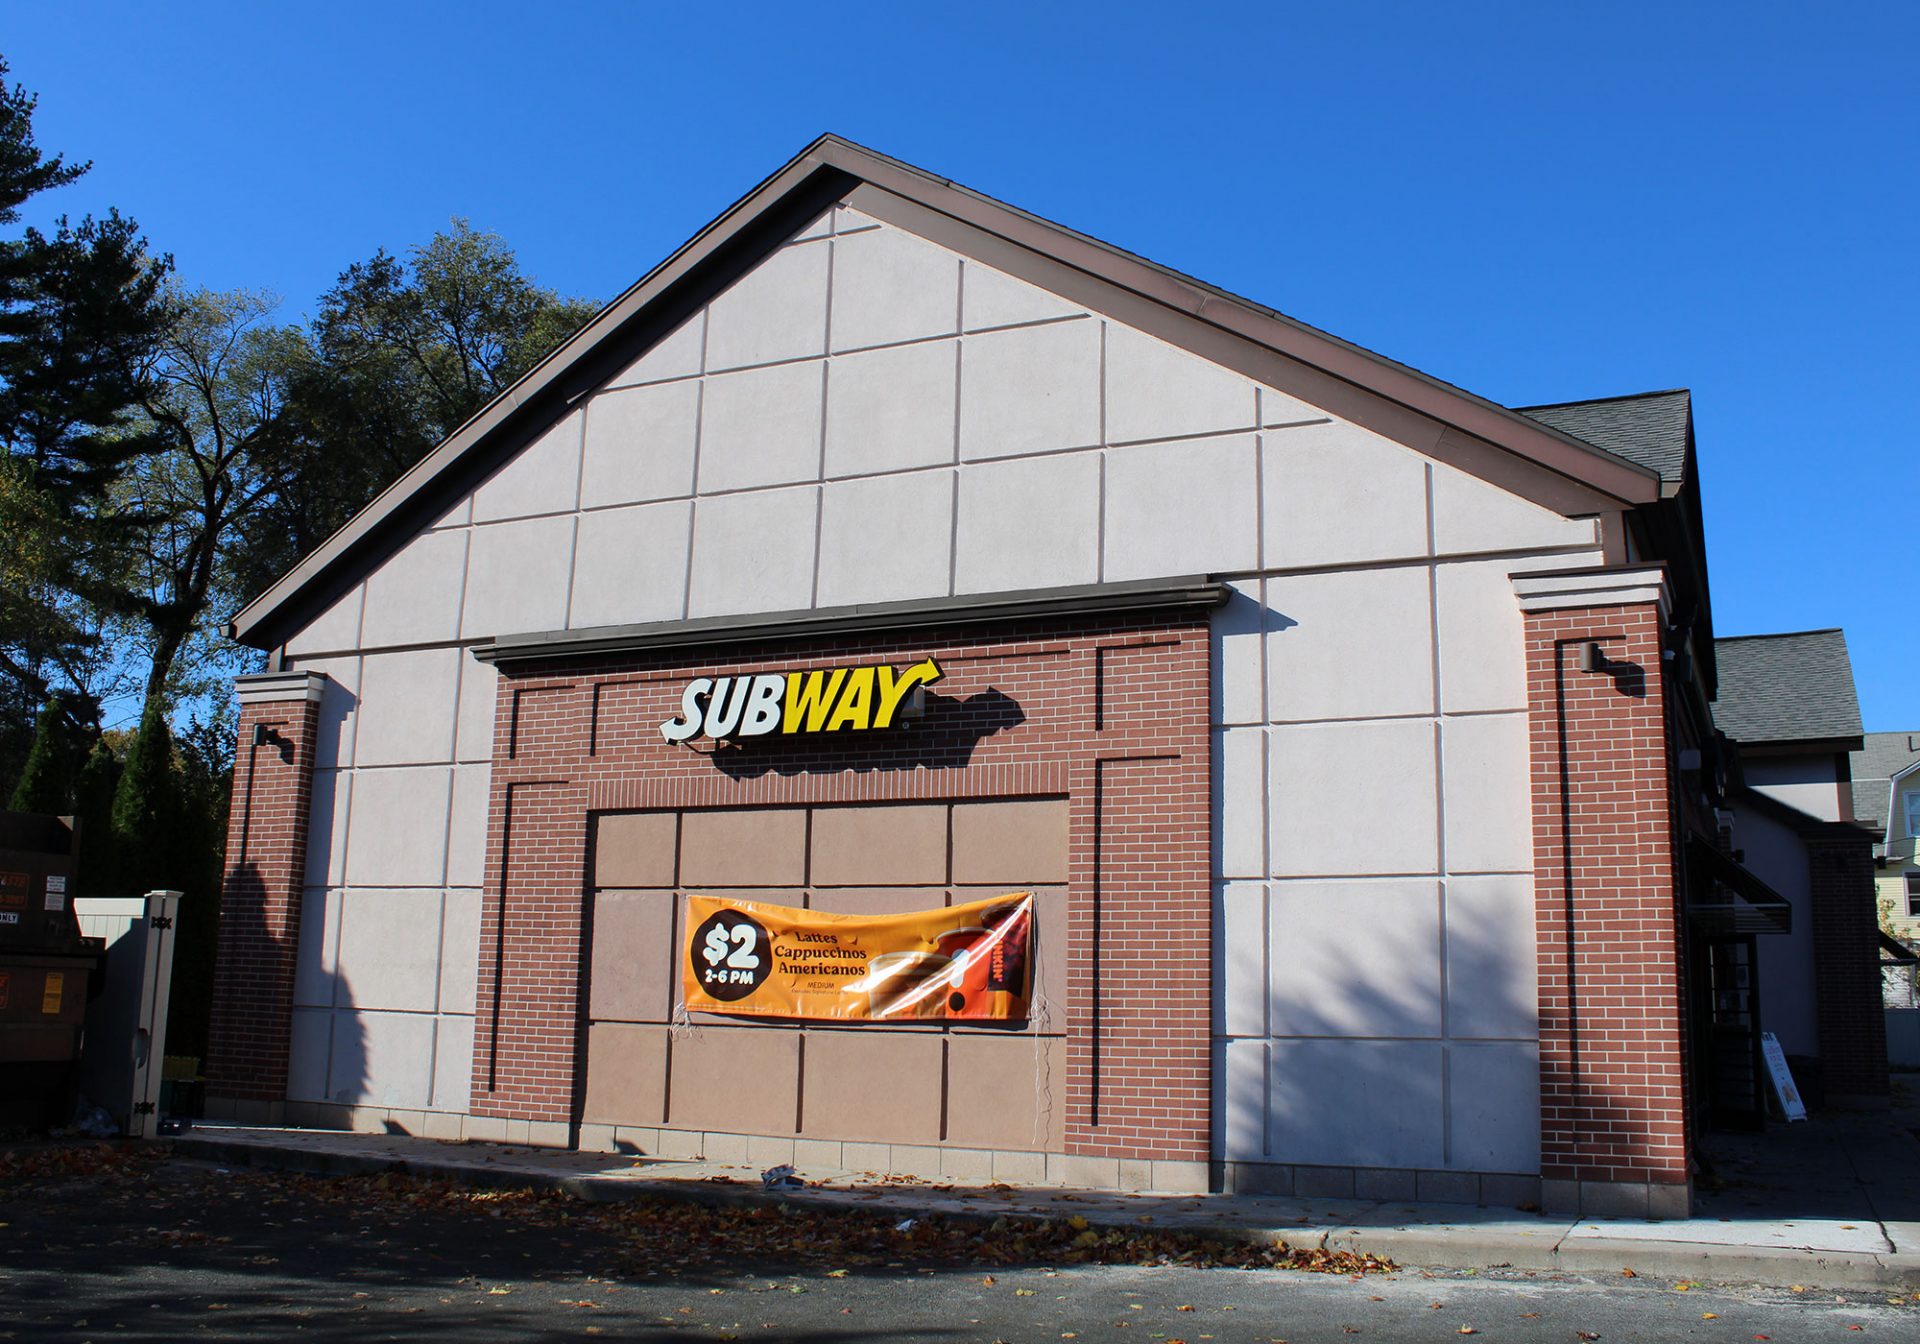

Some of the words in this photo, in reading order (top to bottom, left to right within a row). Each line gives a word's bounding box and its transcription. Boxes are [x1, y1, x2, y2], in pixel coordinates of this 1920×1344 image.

[659, 657, 943, 743] SUBWAY
[795, 931, 838, 944] Lattes
[703, 922, 760, 969] $2
[775, 945, 867, 960] Cappuccinos
[705, 969, 728, 983] 2-6
[730, 970, 753, 984] PM
[779, 962, 865, 976] Americanos
[807, 981, 834, 989] MEDIUM
